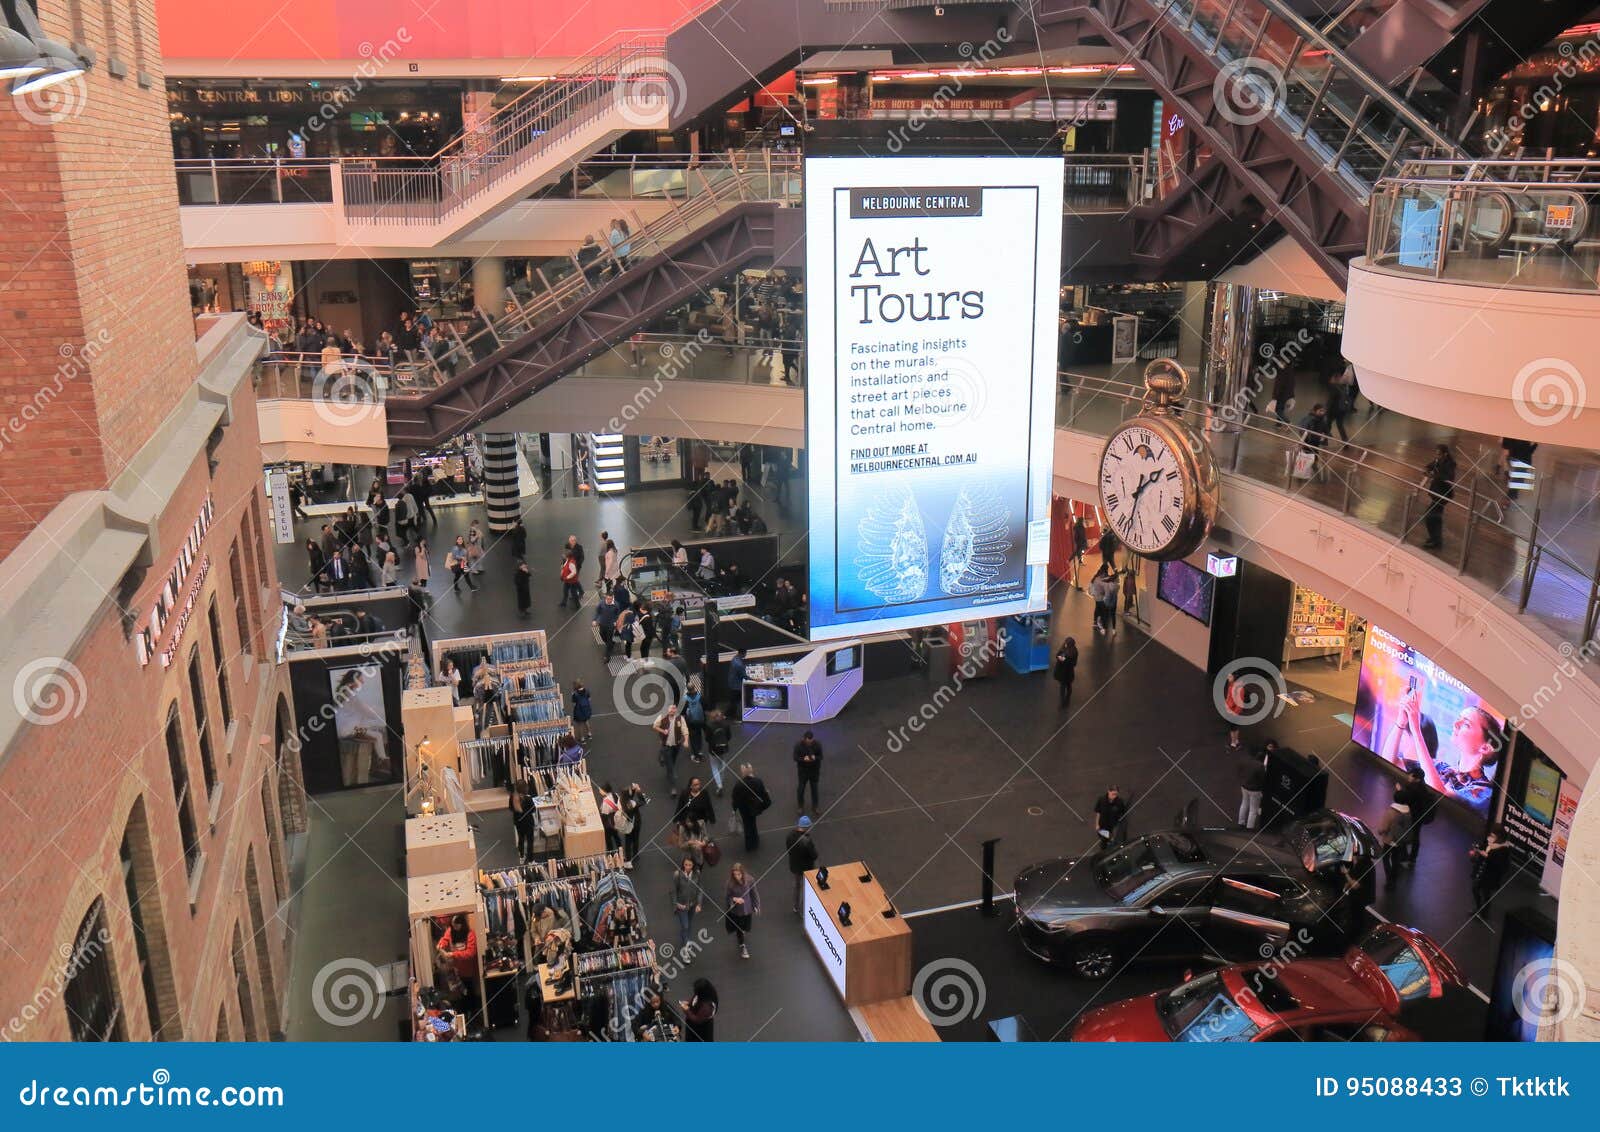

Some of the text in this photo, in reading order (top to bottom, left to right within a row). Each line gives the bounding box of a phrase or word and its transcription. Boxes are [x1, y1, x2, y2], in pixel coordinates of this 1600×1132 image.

[198, 90, 260, 102] CENTRAL
[269, 90, 303, 102] LION
[892, 100, 914, 109] HOYTS
[951, 100, 974, 109] HOYTS
[980, 100, 1003, 109] HOYTS
[863, 196, 970, 209] MELBOURNE CENTRAL
[849, 237, 930, 277] Art
[258, 291, 282, 301] JEANS
[850, 285, 983, 323] Tours
[851, 338, 967, 354] Fascinating insights
[850, 356, 937, 371] on the murals,
[851, 370, 948, 387] installations and
[850, 387, 951, 403] street art pieces
[850, 402, 967, 419] that call Melbourne
[850, 420, 936, 435] Central home.
[851, 443, 928, 460] FIND OUT MORE AT
[277, 495, 289, 538] MUSEUM
[1370, 635, 1414, 666] hotspots
[1415, 660, 1473, 694] worldwide
[1507, 803, 1521, 818] The
